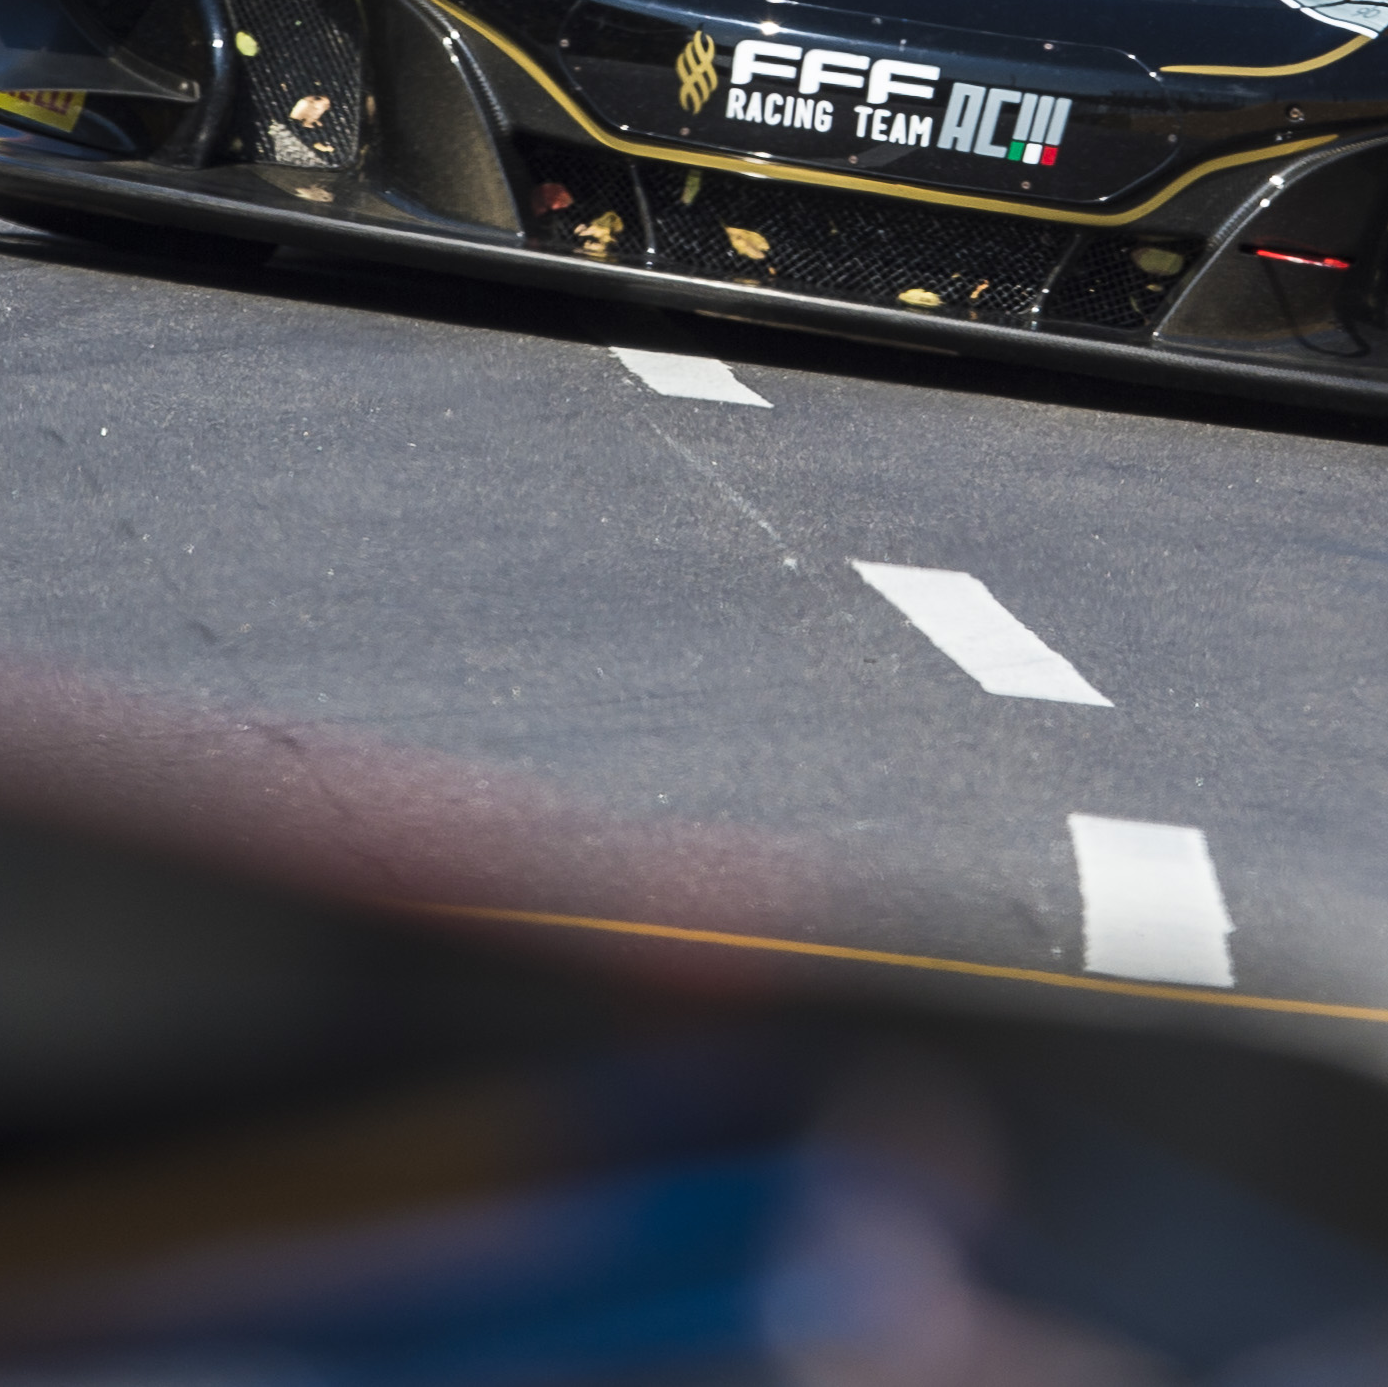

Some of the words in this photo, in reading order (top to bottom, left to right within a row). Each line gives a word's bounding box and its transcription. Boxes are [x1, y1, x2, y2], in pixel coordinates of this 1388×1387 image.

[730, 39, 941, 105] FFF
[725, 88, 834, 133] RACING
[853, 105, 933, 148] TEAM
